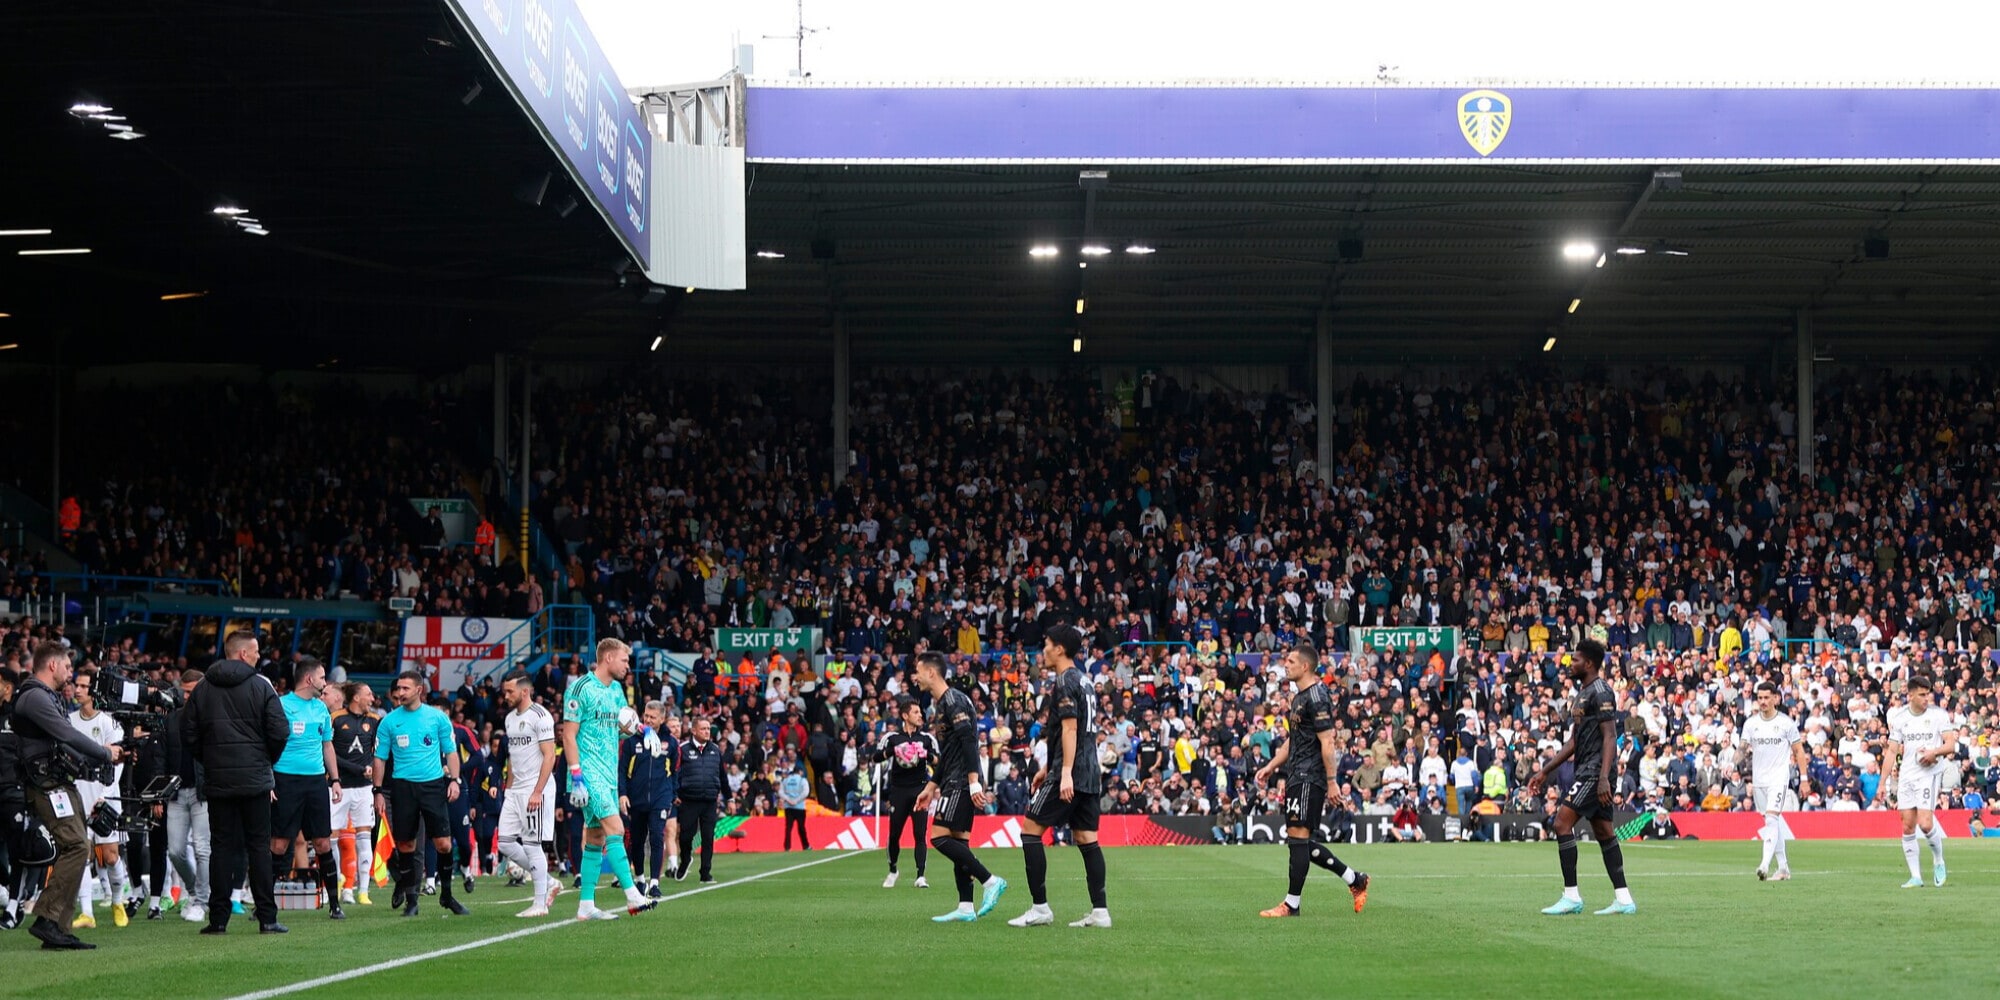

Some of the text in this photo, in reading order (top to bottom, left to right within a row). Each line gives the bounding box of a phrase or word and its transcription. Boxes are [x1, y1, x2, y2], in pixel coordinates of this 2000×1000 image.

[525, 0, 552, 63] BOOST
[565, 46, 588, 118] BOOST
[598, 100, 618, 164] BOOST
[627, 146, 643, 205] BOOST
[731, 632, 770, 647] EXIT
[1373, 632, 1413, 647] EXIT
[1568, 781, 1582, 796] 5
[1923, 788, 1930, 799] 8
[936, 797, 949, 813] 11
[1775, 792, 1782, 804] 5
[526, 815, 536, 829] 11
